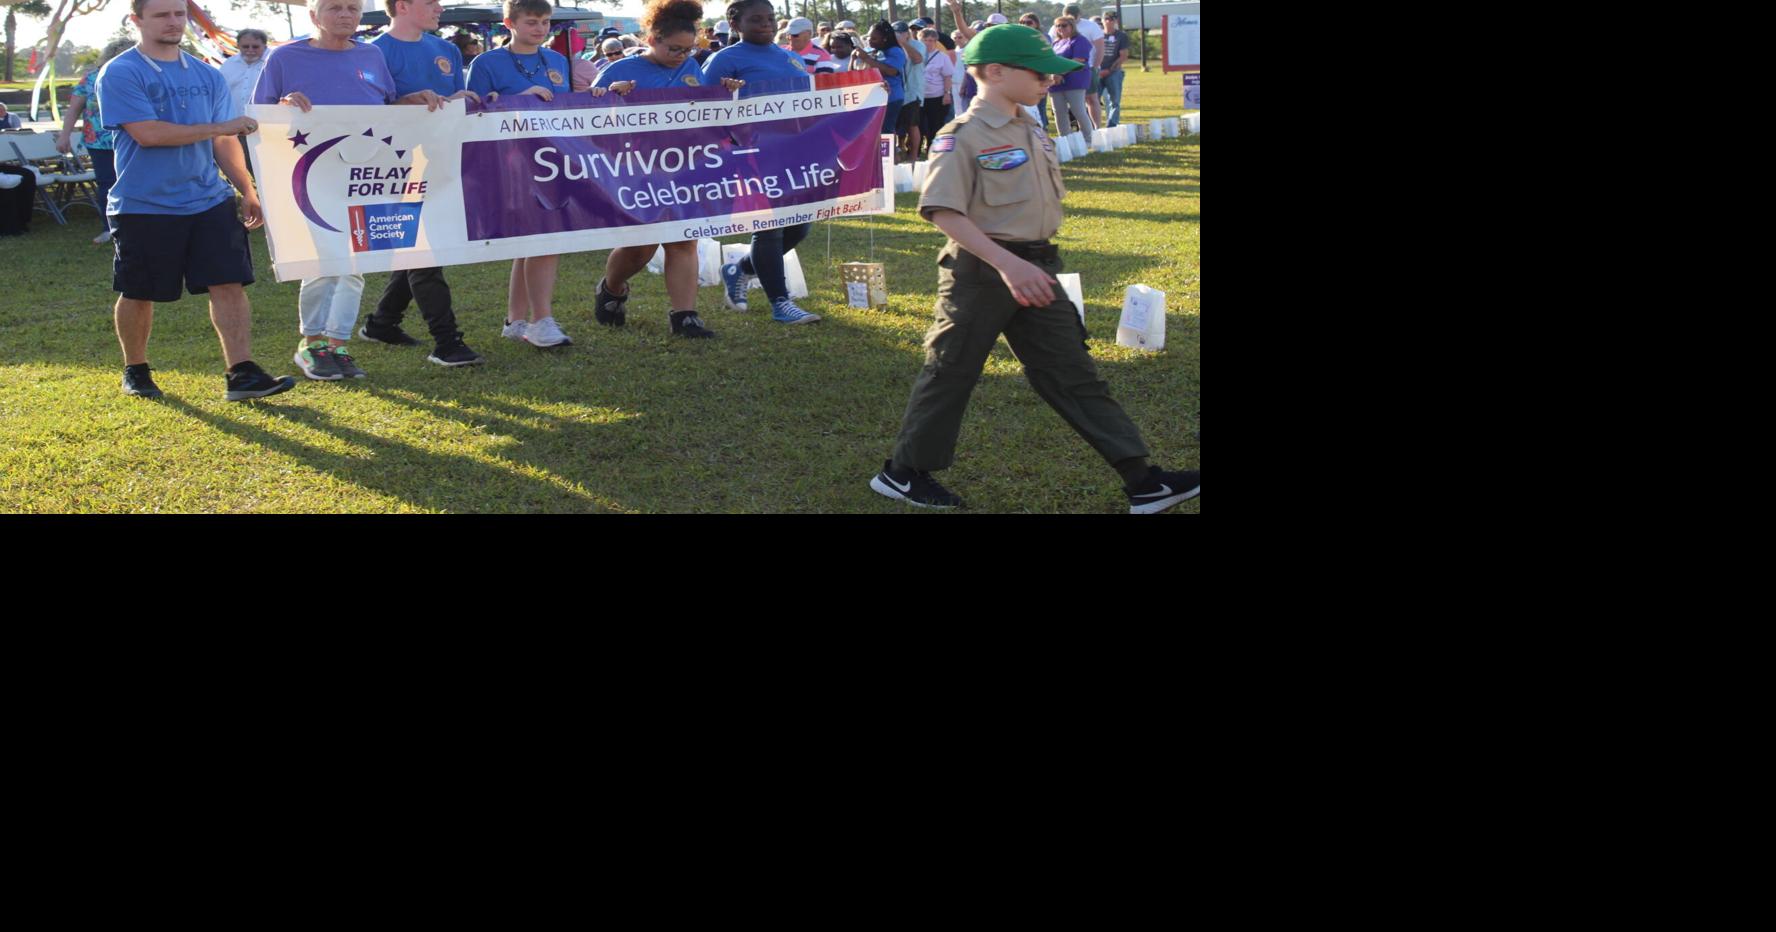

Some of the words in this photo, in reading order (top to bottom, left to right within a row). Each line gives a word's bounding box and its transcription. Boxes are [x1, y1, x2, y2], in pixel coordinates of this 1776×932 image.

[500, 117, 584, 133] AMERICAN
[591, 112, 659, 129] CANCER
[665, 107, 734, 124] SOCIETY
[737, 100, 785, 118] RELAY
[792, 97, 823, 112] FOR
[829, 92, 860, 108] LIFE
[533, 142, 723, 182] Survivors
[350, 166, 412, 181] RELAY
[347, 182, 384, 197] FOR
[389, 180, 428, 195] LIFE
[617, 174, 783, 209] Celebrating
[785, 163, 839, 190] Life.
[368, 214, 414, 223] American
[369, 223, 401, 231] Cancer
[683, 223, 749, 239] Celebrate.
[816, 206, 840, 219] Fight
[370, 230, 405, 240] Society
